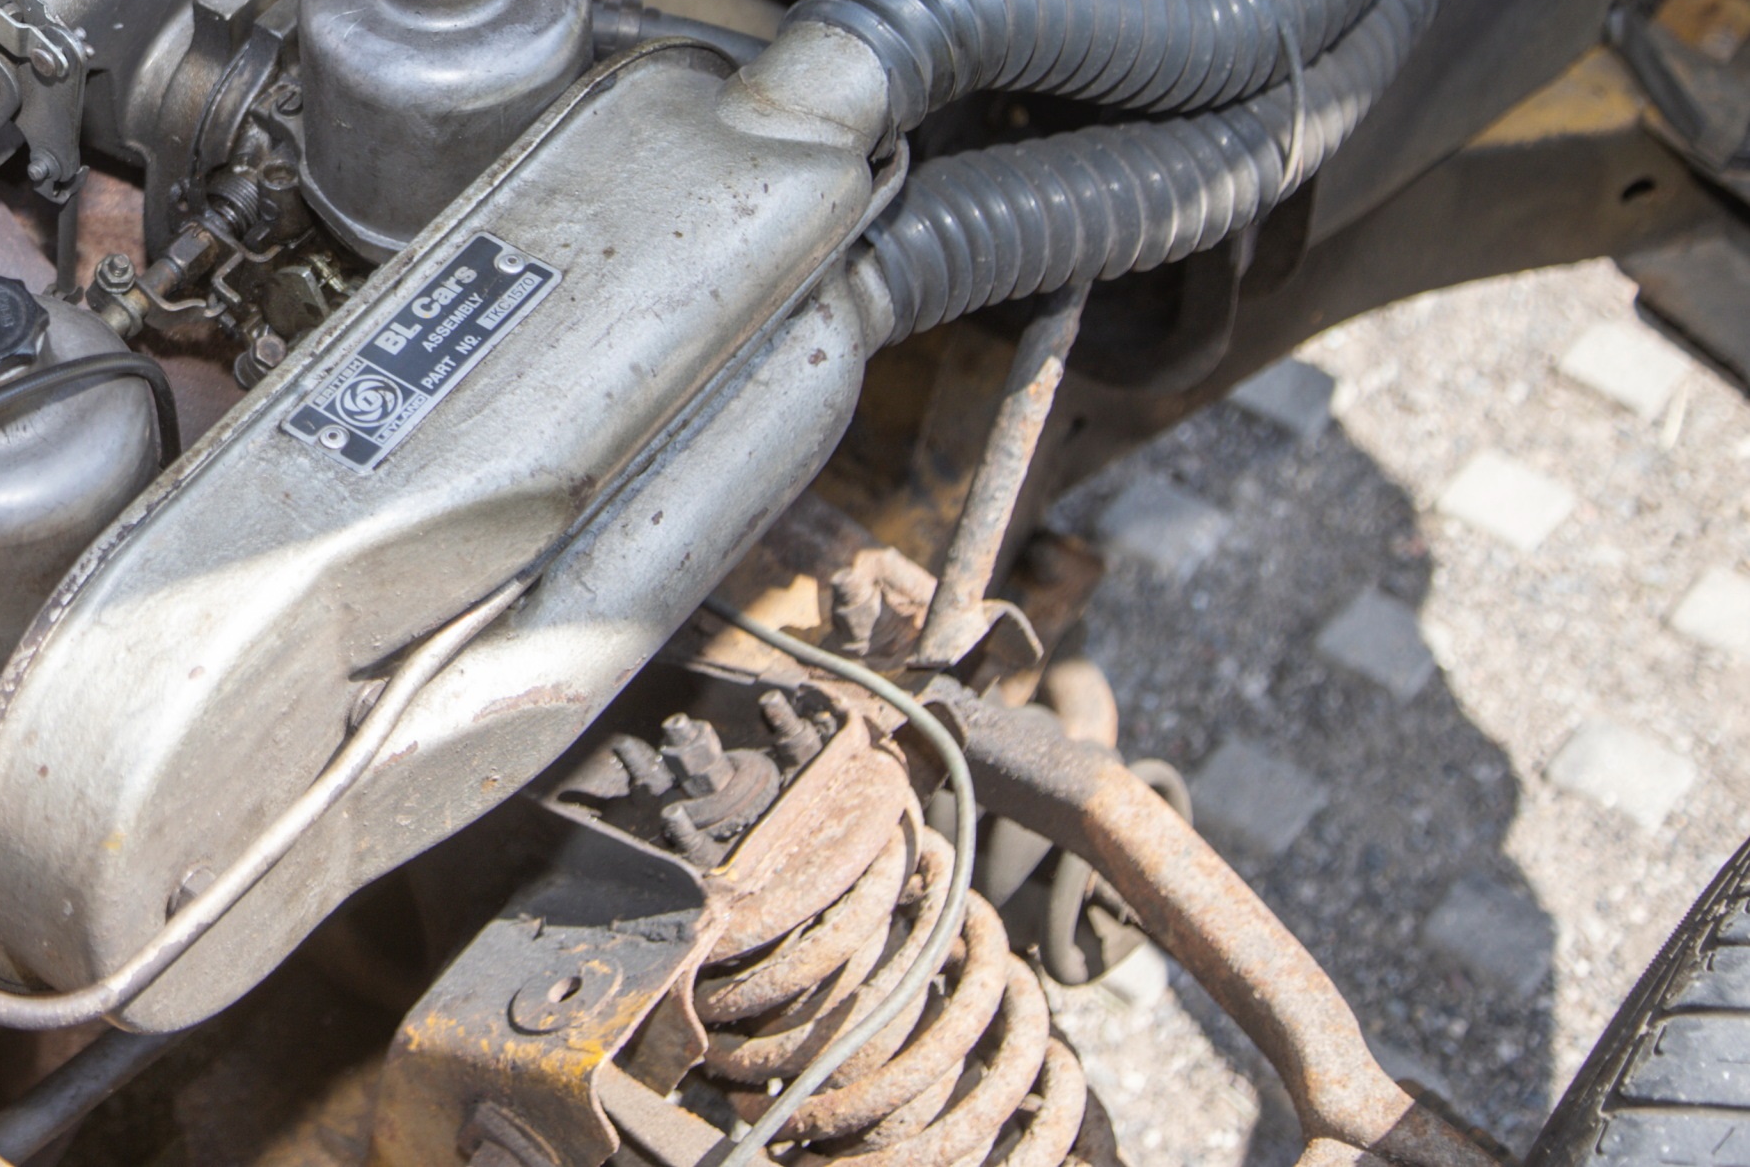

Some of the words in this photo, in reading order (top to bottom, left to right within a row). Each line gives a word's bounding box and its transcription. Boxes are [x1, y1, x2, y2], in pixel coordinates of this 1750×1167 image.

[373, 322, 423, 356] BL
[411, 265, 478, 320] Cars
[421, 292, 484, 353] ASSEMBLY
[313, 358, 363, 408] BRITISH
[420, 356, 457, 389] PART
[376, 395, 428, 444] LEYLAND
